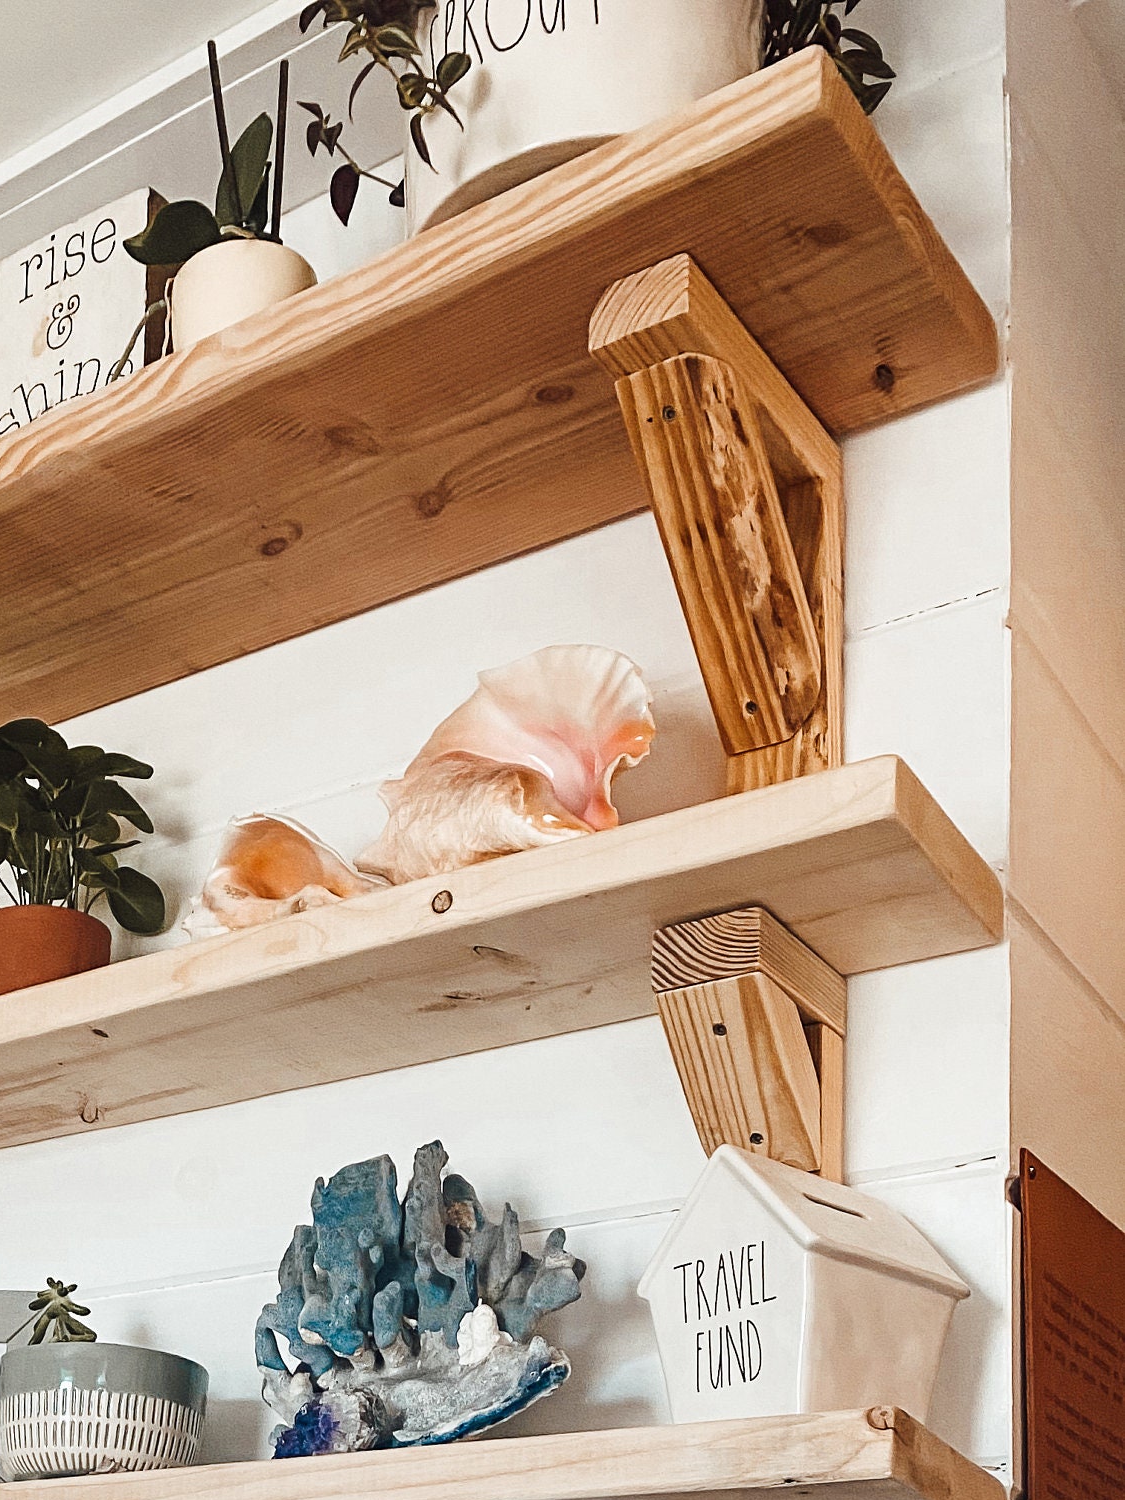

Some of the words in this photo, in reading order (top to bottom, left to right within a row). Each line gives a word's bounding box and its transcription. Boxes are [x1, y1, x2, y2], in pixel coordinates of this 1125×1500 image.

[19, 216, 117, 304] rise
[46, 295, 81, 350] &
[674, 1241, 776, 1323] TRAVEL
[696, 1320, 762, 1393] FUND
